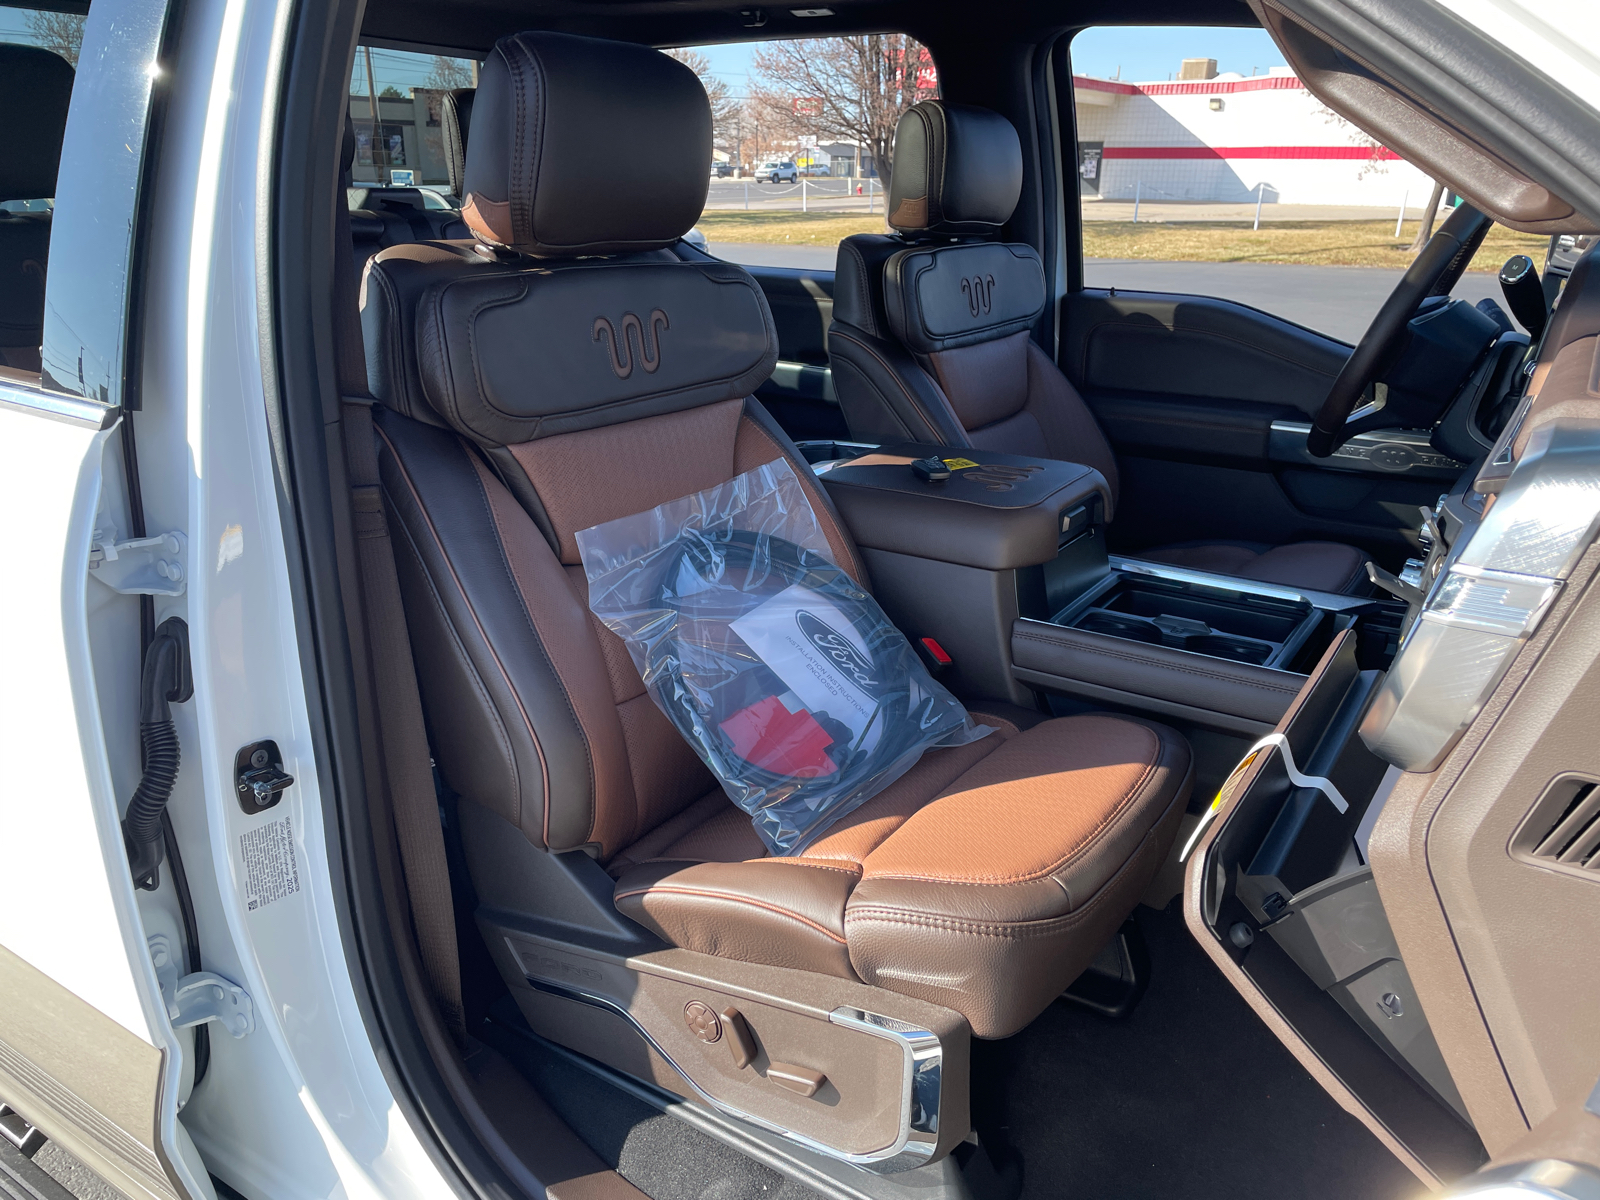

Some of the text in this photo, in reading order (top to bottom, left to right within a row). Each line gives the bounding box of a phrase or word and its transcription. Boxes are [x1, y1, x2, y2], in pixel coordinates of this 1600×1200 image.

[785, 635, 870, 719] INSTALLATION INSTRUCTIONS
[805, 663, 838, 696] ENCLOSED
[814, 633, 879, 690] Ford
[521, 952, 603, 981] FORD
